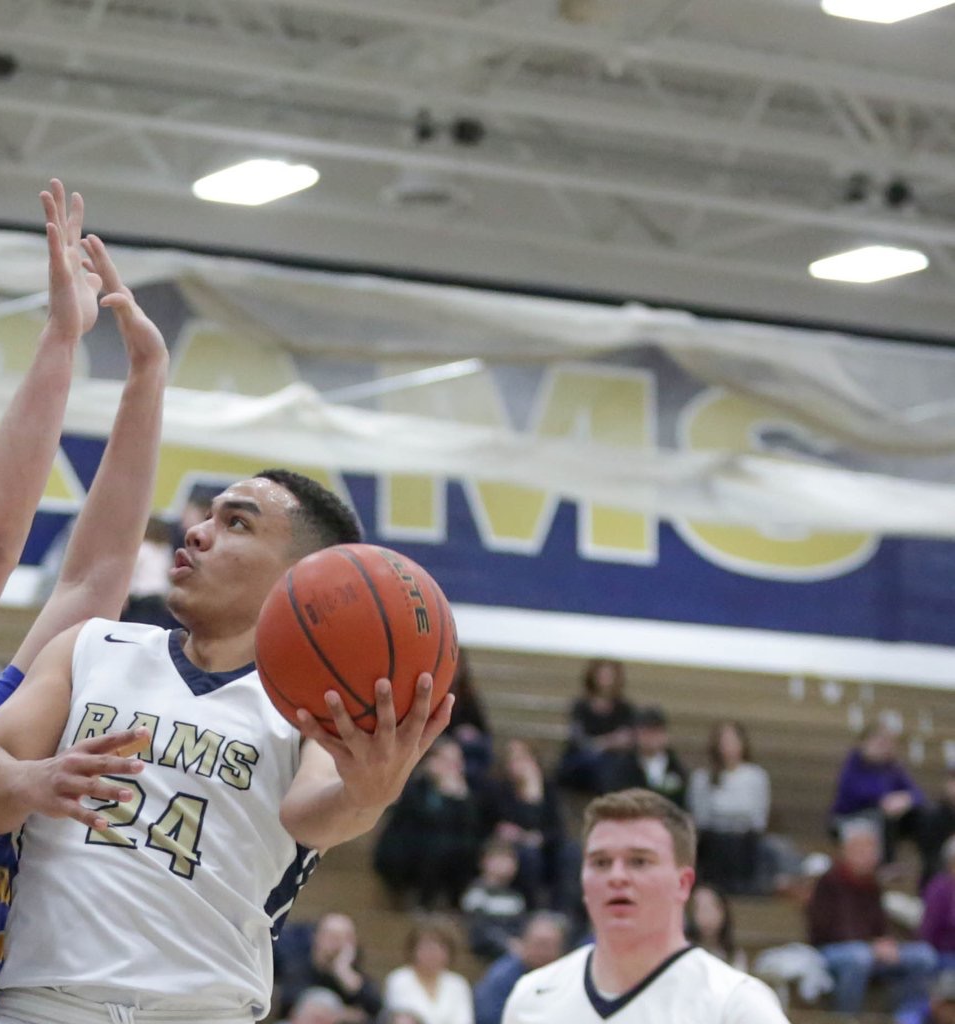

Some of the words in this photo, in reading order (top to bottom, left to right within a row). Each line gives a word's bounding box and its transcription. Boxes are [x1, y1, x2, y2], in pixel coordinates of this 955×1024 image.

[378, 549, 430, 635] LITE
[72, 702, 259, 790] RAMS
[84, 775, 209, 880] 24
